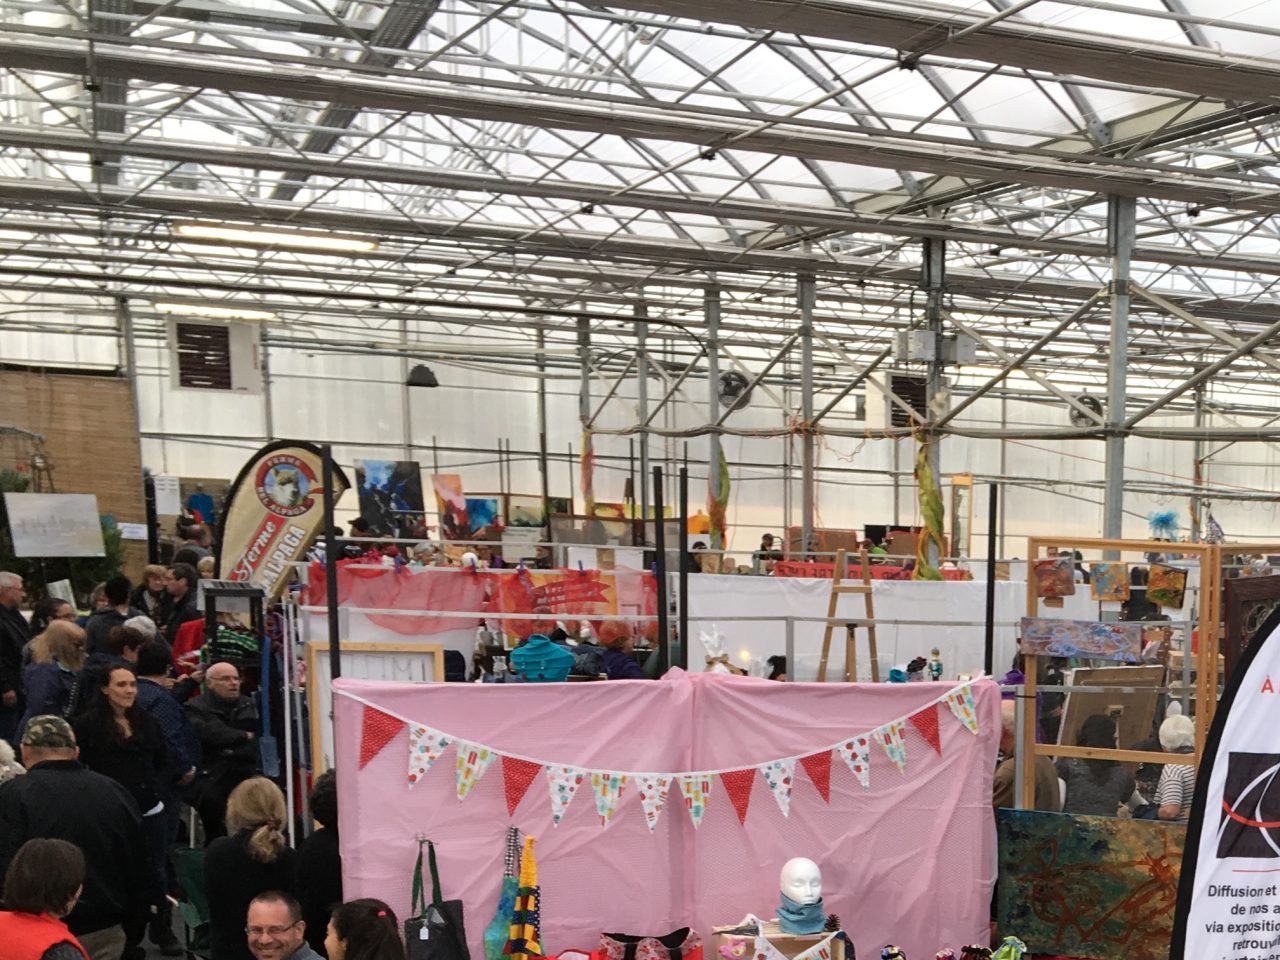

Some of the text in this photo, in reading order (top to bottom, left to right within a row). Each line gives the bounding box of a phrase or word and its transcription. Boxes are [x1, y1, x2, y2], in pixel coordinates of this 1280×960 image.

[1261, 675, 1274, 693] À
[1208, 885, 1263, 897] Diffusion
[1265, 885, 1277, 896] et
[1230, 903, 1246, 915] de
[1250, 904, 1269, 914] nos
[1205, 921, 1224, 933] via
